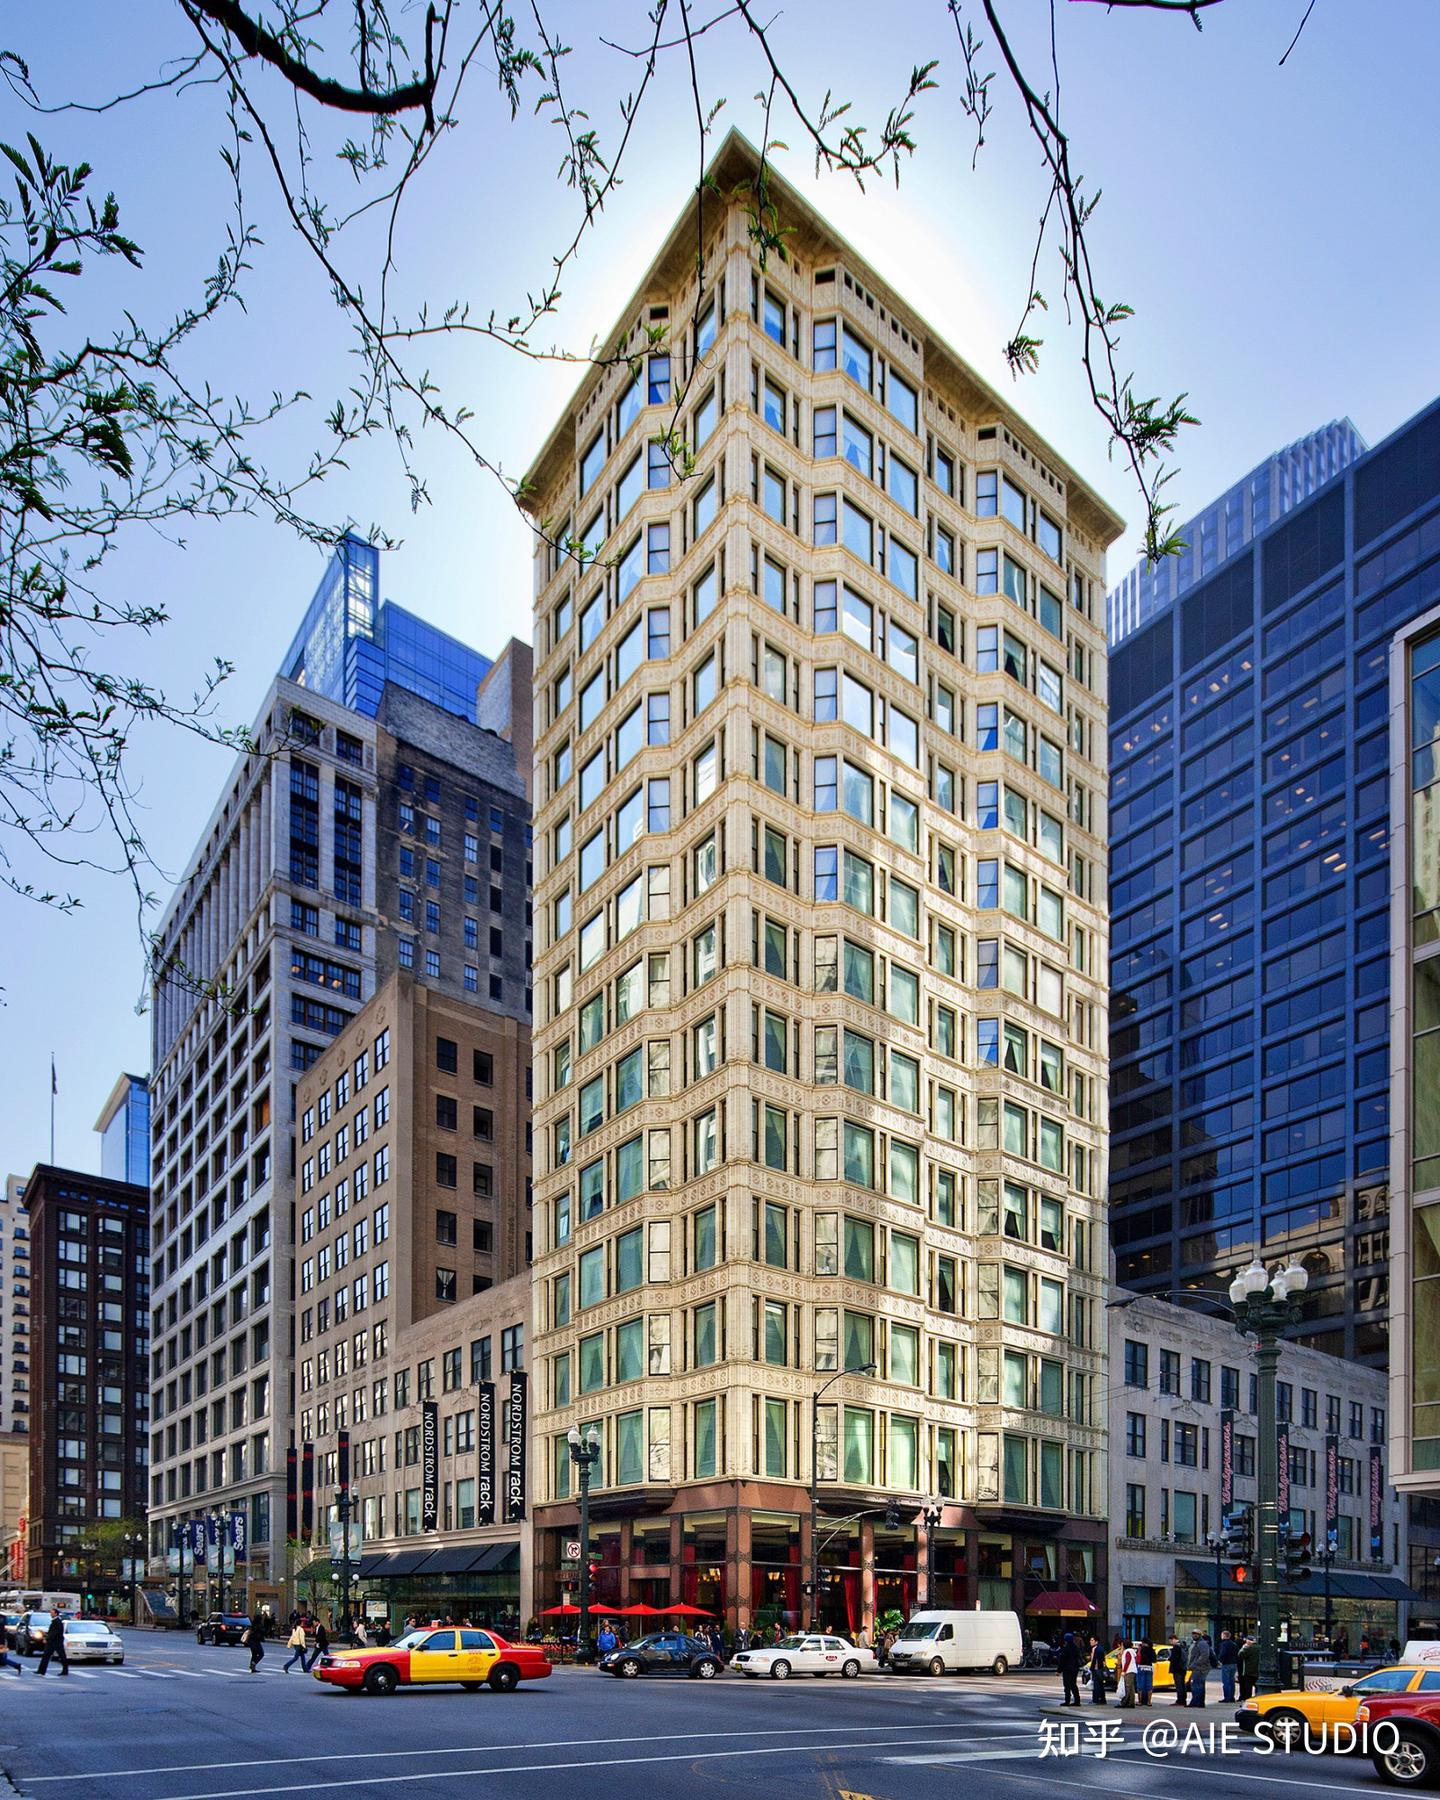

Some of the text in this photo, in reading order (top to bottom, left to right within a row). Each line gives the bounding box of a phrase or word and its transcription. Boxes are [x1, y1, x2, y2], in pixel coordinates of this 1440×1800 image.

[424, 1411, 436, 1518] NORDSTROM rack
[480, 1393, 493, 1510] NORDSTROM rack
[510, 1383, 524, 1506] NORDSTROM rack
[194, 1524, 204, 1555] Sears
[233, 1516, 244, 1551] Sears
